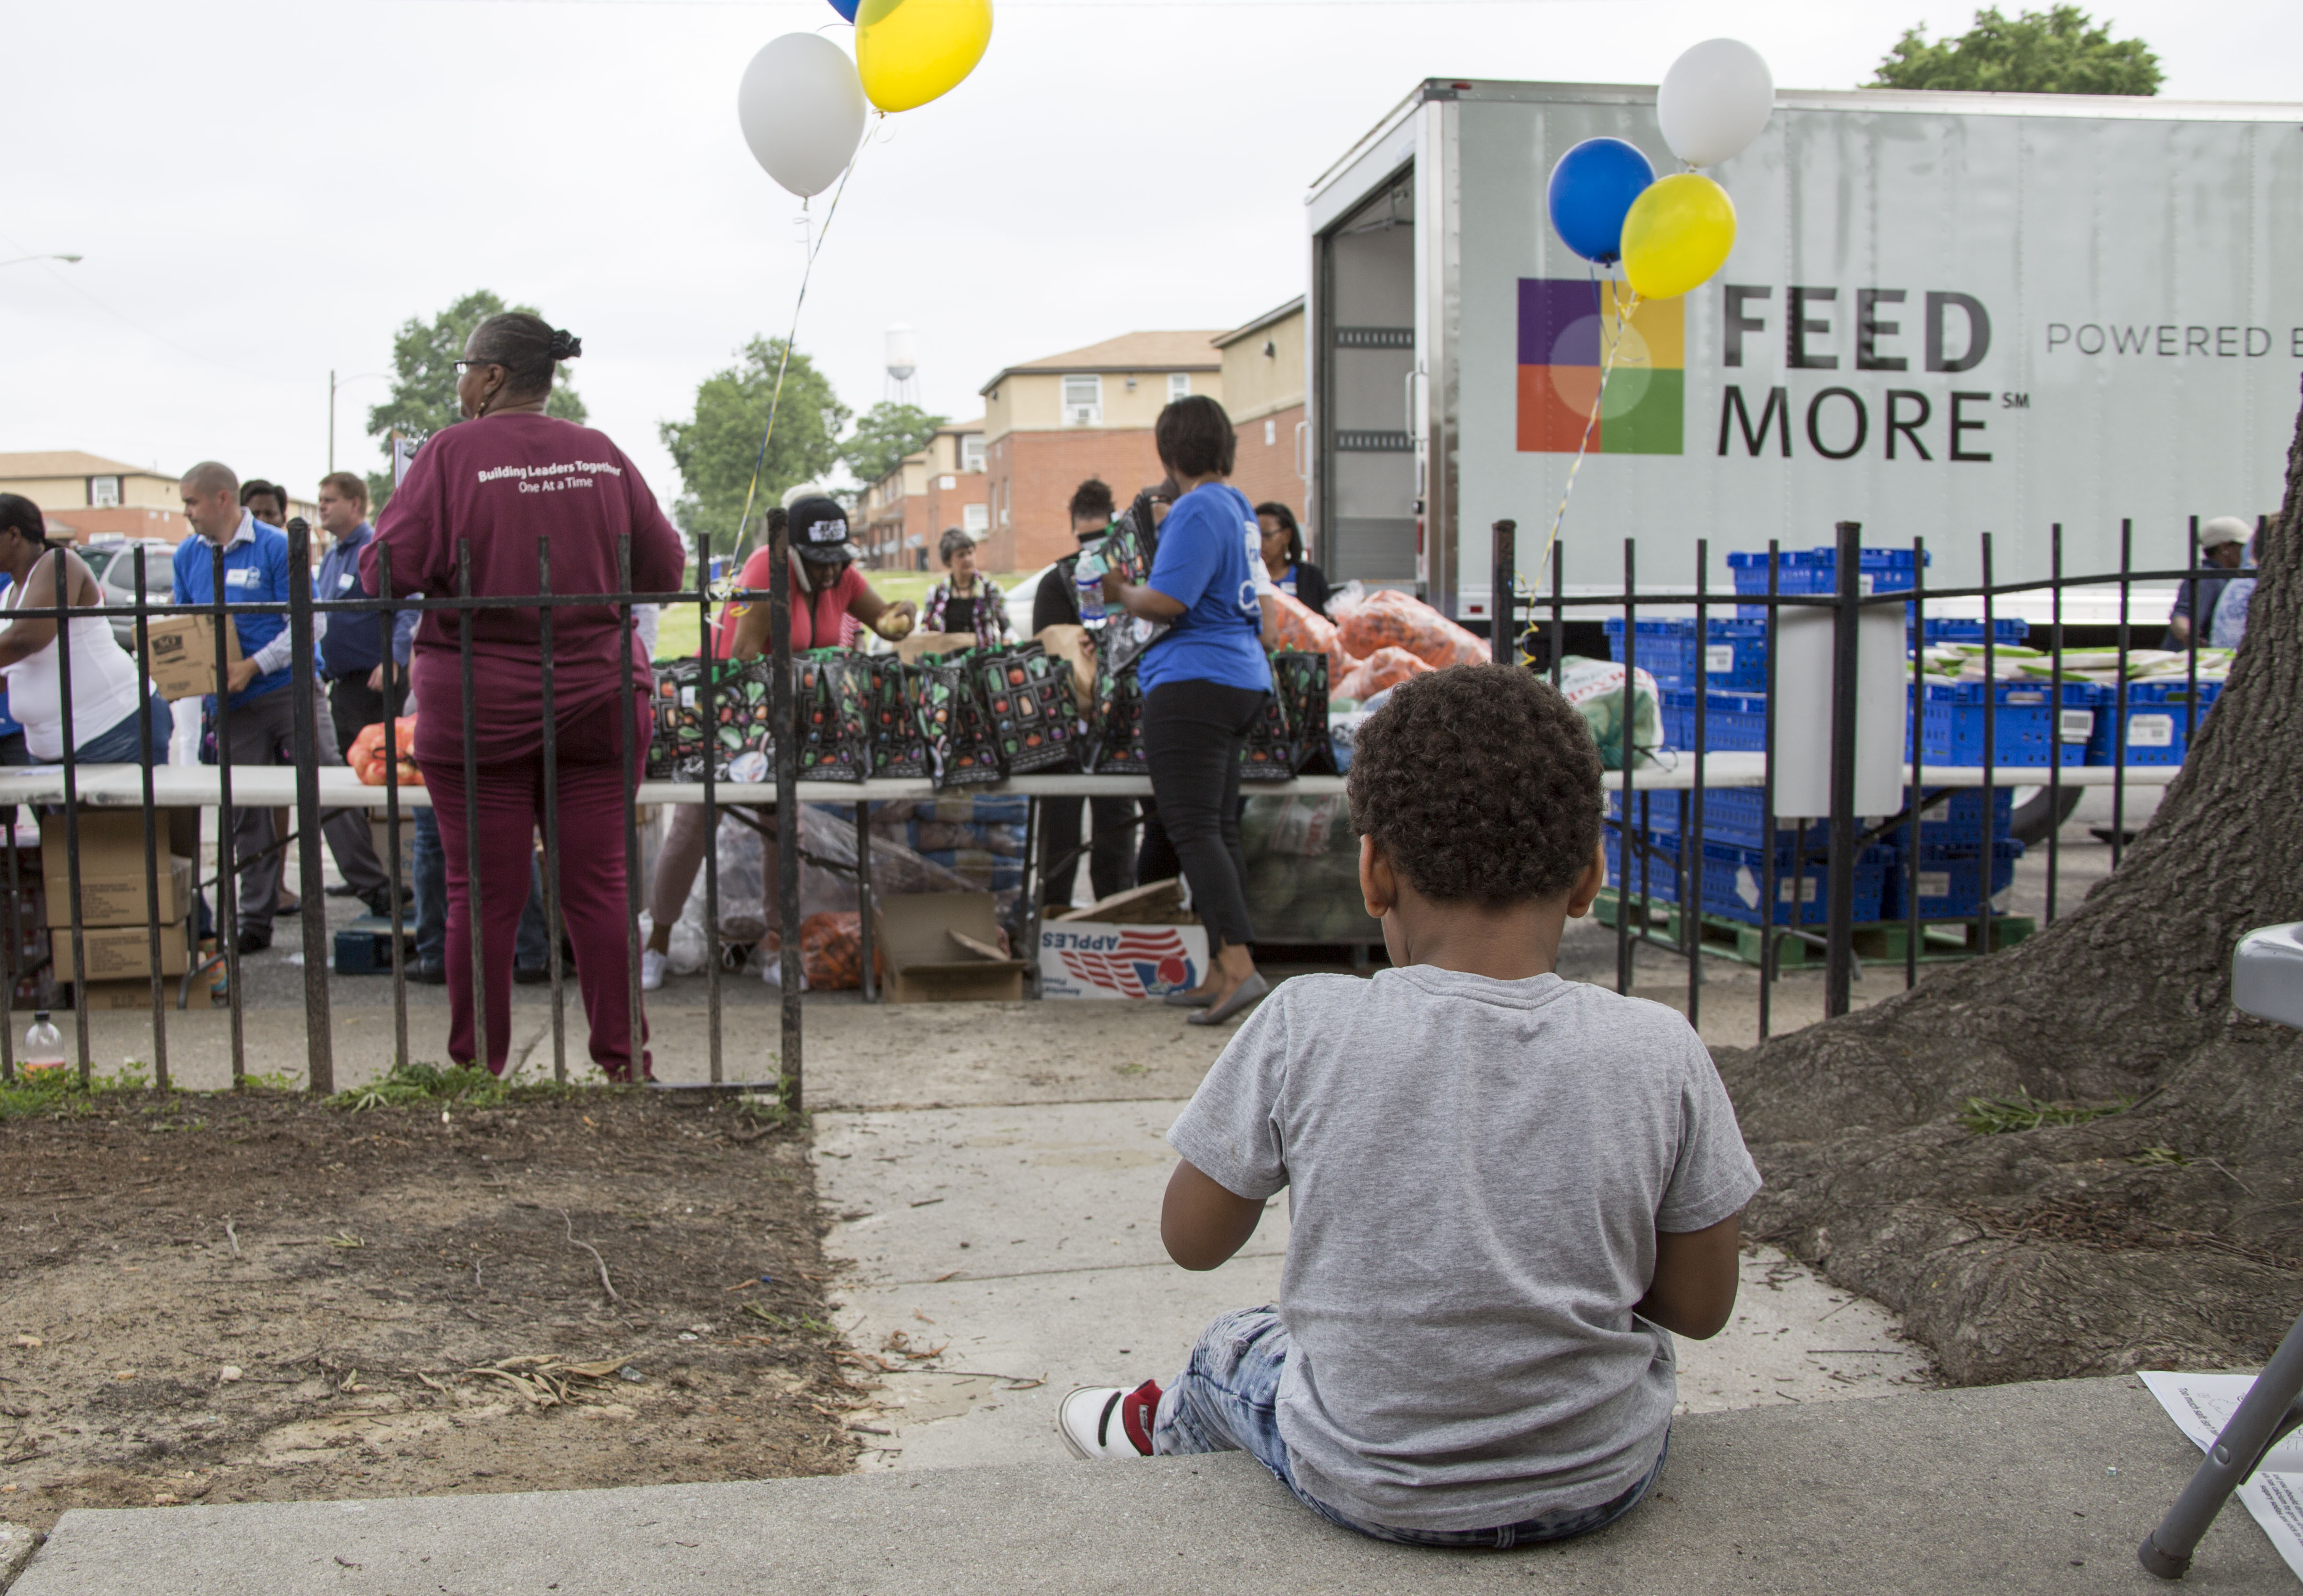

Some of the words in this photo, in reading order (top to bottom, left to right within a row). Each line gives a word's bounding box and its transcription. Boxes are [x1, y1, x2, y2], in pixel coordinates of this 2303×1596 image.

[1724, 284, 1991, 373] FEED
[2047, 322, 2272, 357] POWERED
[1717, 385, 1992, 463] MORE
[2002, 391, 2030, 409] SM
[478, 465, 527, 482] Building
[528, 463, 575, 477] Leaders
[574, 460, 621, 477] Together
[518, 481, 539, 493] One
[542, 480, 555, 491] At
[557, 481, 564, 490] a
[565, 477, 593, 488] Time
[1042, 931, 1118, 950] APPLES
[2178, 1387, 2189, 1396] Too
[2184, 1396, 2201, 1409] much
[2193, 1410, 2207, 1419] salt
[2272, 1487, 2287, 1504] calcium
